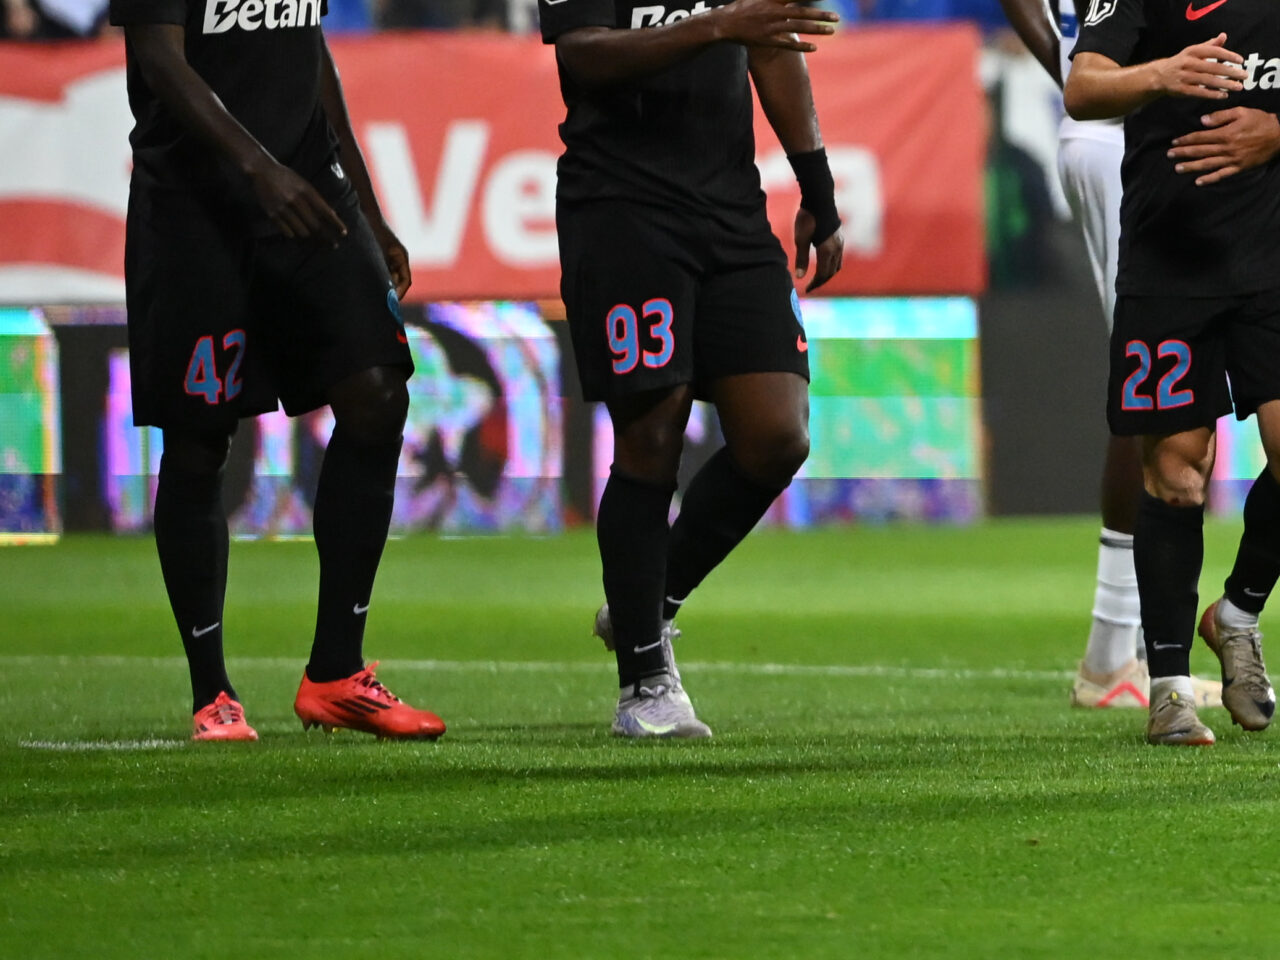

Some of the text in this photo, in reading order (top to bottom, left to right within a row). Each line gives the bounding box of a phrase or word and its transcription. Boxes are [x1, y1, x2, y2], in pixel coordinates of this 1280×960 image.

[184, 328, 246, 405] 42
[605, 297, 675, 374] 93
[1120, 339, 1194, 411] 22
